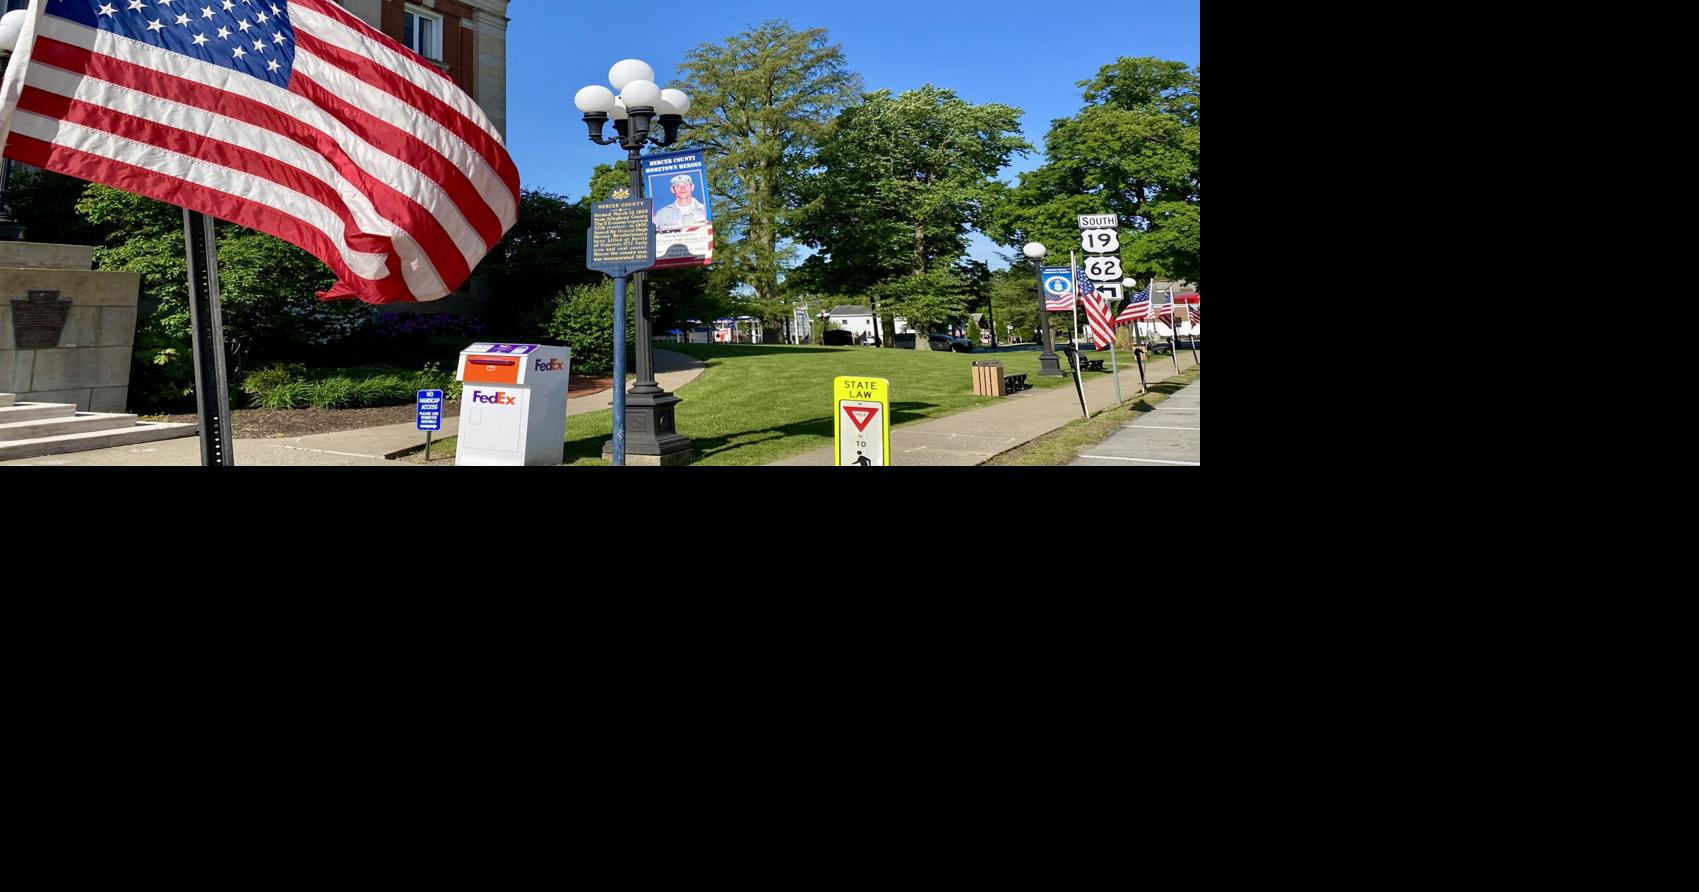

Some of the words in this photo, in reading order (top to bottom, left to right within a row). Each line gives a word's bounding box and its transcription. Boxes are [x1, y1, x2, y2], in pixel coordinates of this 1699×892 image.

[673, 155, 696, 163] COUNTY
[645, 164, 678, 173] HOMETOWN
[679, 161, 702, 169] HEROES
[1082, 217, 1114, 225] SOUTH
[1088, 233, 1111, 248] 19
[1091, 261, 1115, 276] 62
[535, 358, 563, 372] FedEx
[844, 381, 877, 390] STATE
[473, 390, 515, 405] FedEx
[849, 390, 872, 399] LAW
